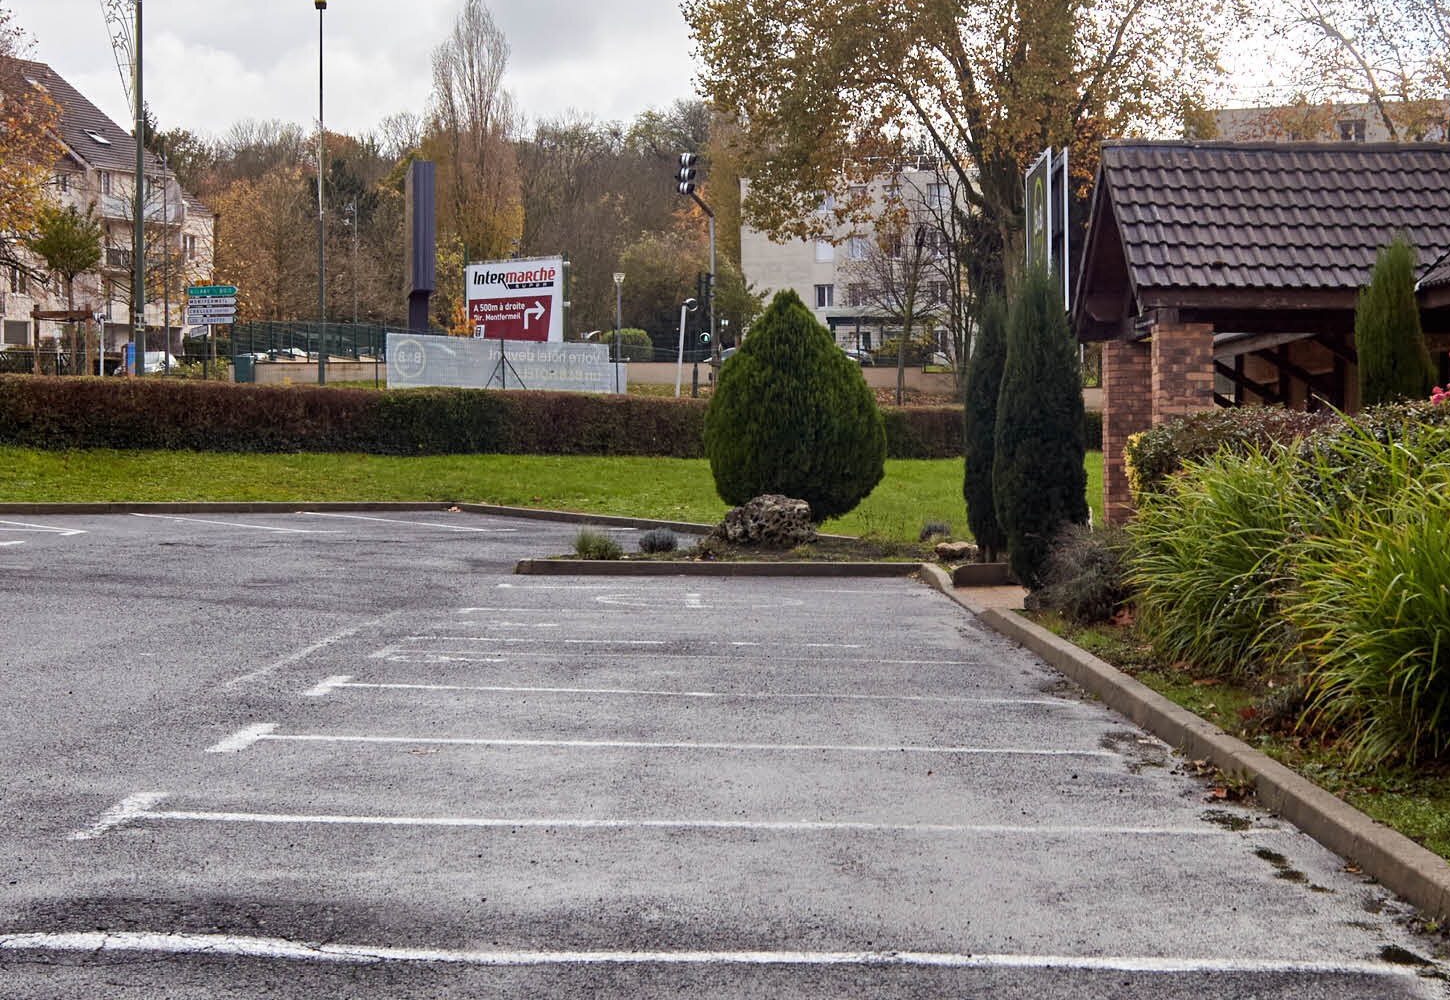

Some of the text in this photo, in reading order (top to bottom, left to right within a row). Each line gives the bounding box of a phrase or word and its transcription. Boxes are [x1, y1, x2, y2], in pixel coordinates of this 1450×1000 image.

[473, 267, 556, 289] Intermarché
[473, 302, 526, 312] A 500m à droite
[485, 312, 521, 321] Montfermeil
